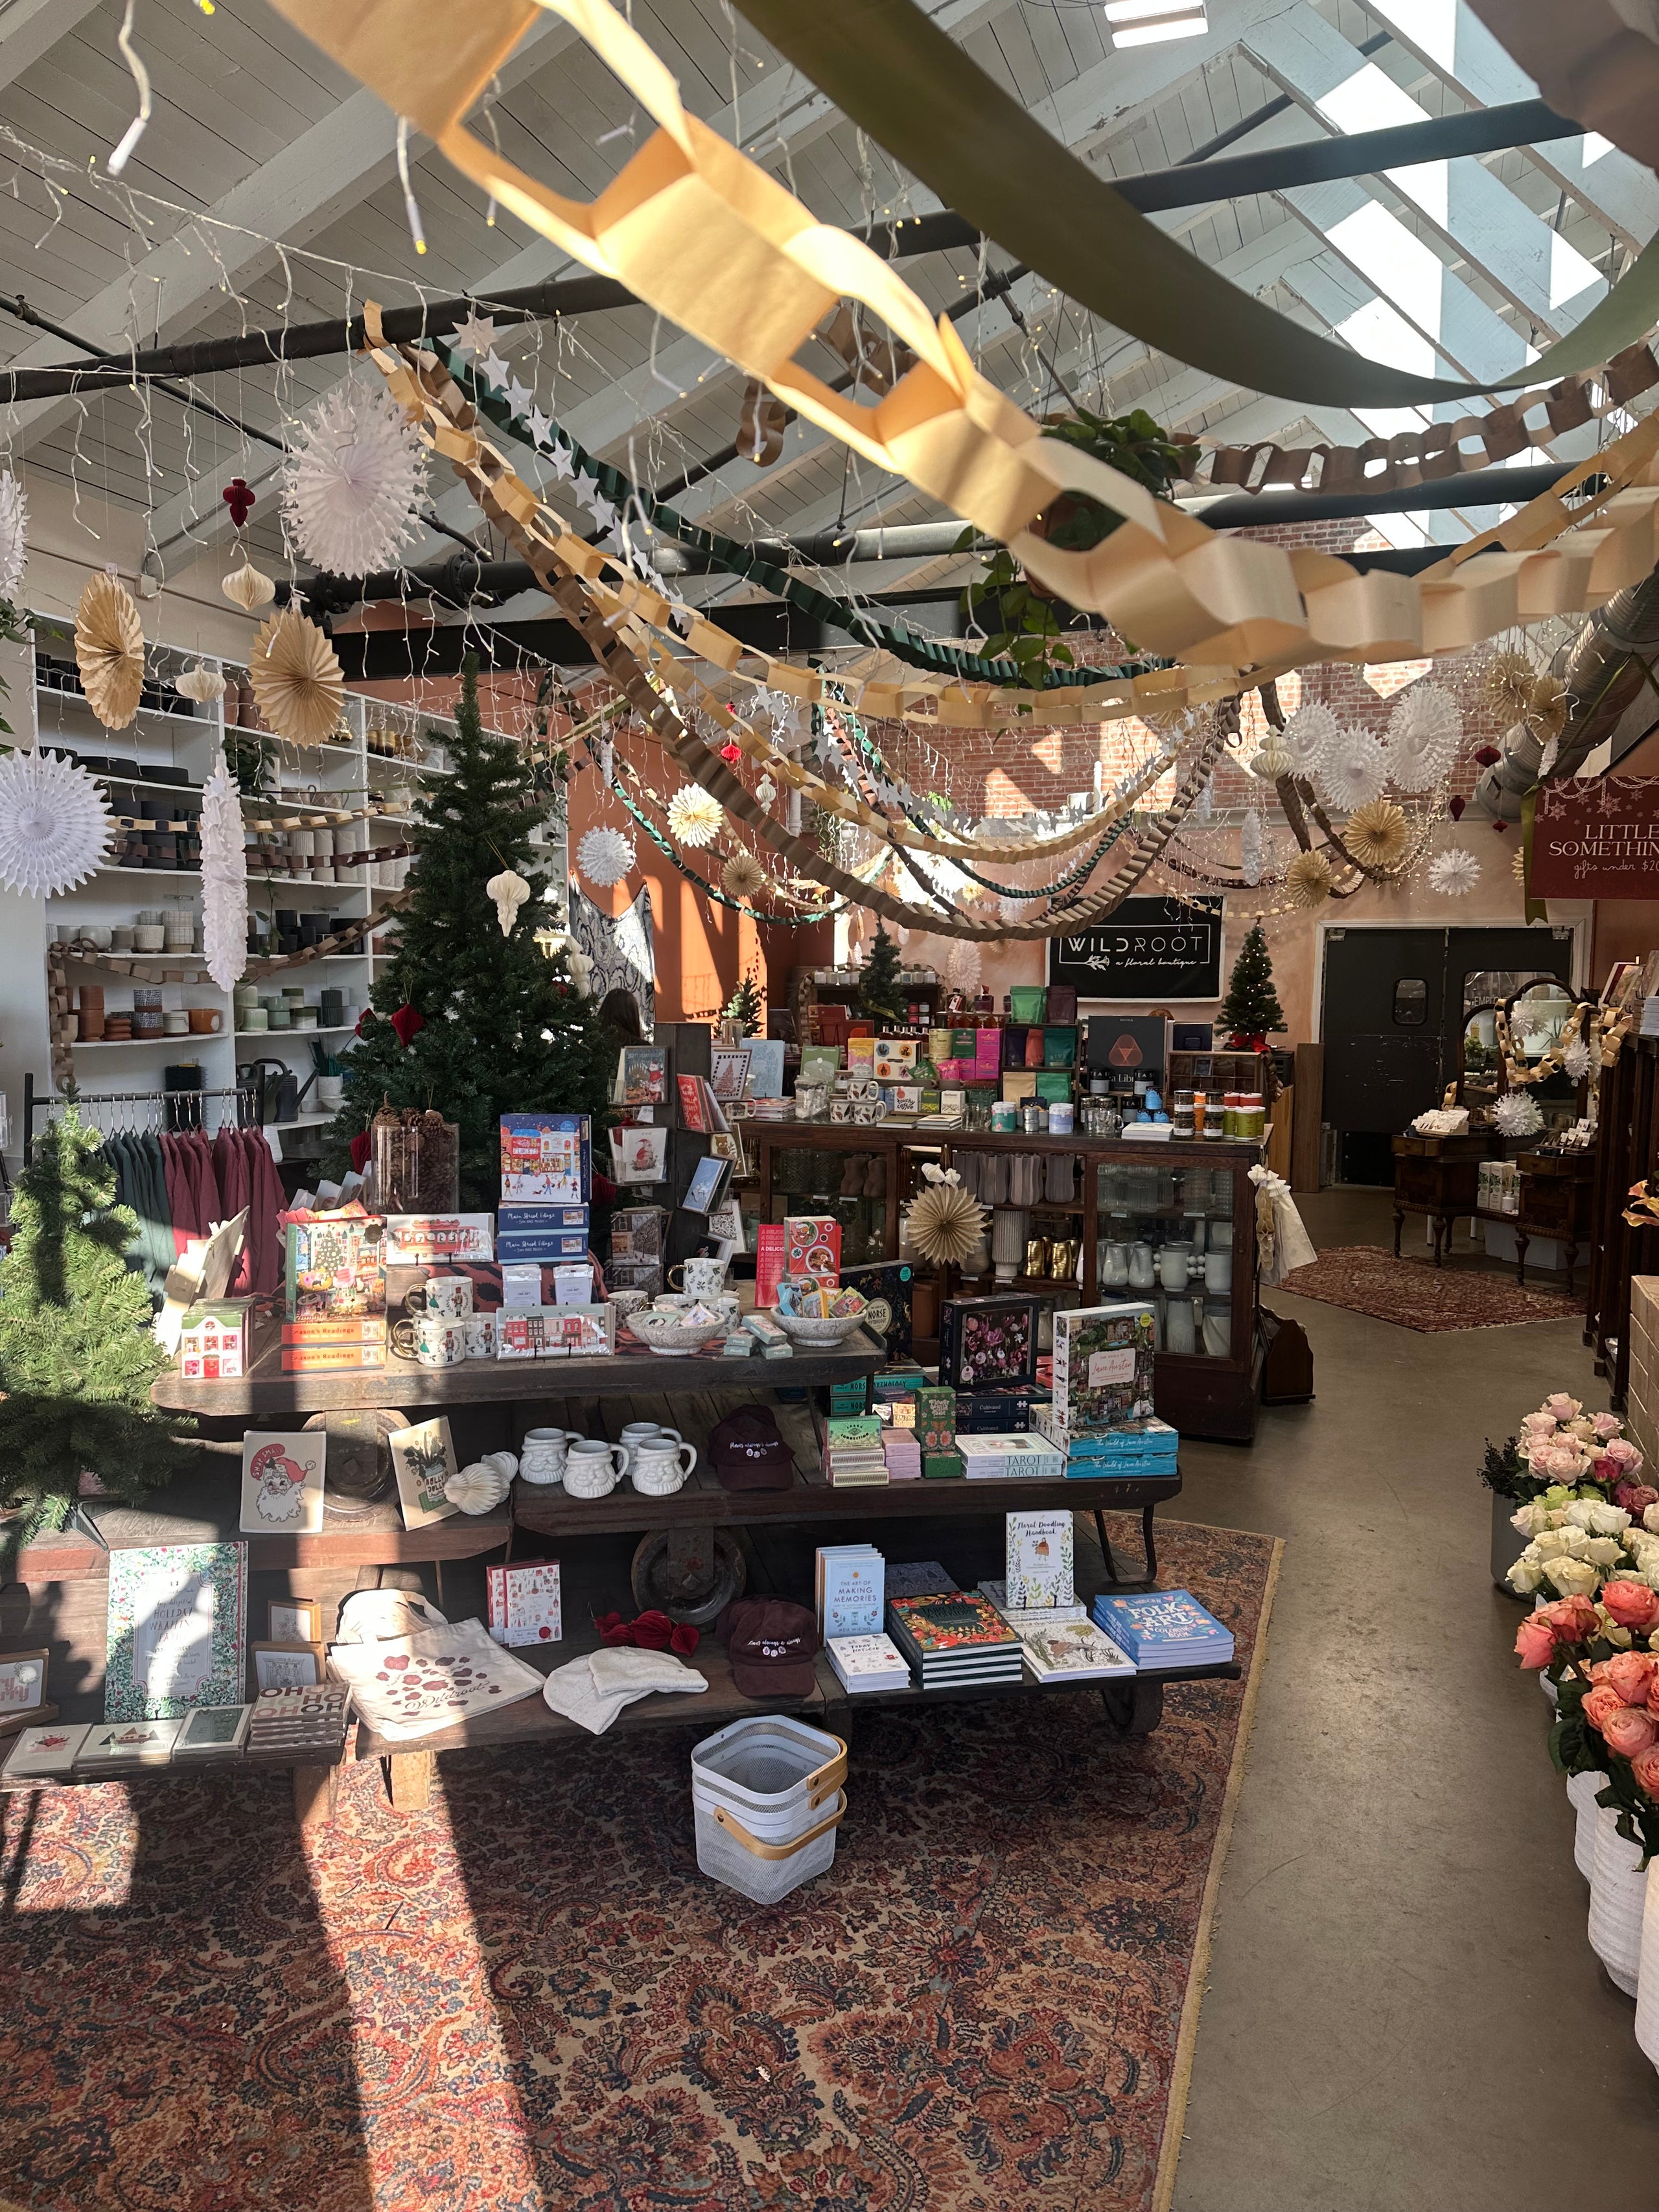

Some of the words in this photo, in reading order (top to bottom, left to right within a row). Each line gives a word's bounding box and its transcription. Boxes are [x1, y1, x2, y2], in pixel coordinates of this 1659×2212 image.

[1585, 824, 1659, 839] LITTLE
[1549, 841, 1659, 856] SOMETHIN
[1574, 859, 1598, 879] gifts
[1603, 859, 1636, 871] under
[1068, 937, 1202, 952] WILDROOT
[1124, 957, 1155, 968] floral
[1157, 957, 1197, 969] boutique
[868, 1309, 886, 1320] NORSE
[1091, 1362, 1108, 1375] Jane
[1109, 1358, 1131, 1372] Austen
[1007, 1455, 1041, 1465] TAROT
[1135, 1459, 1151, 1467] Austen
[1006, 1467, 1040, 1476] TAROT
[1038, 1520, 1065, 1529] Doodling
[1025, 1528, 1056, 1537] Handbook
[1128, 1601, 1184, 1620] FOLK
[1139, 1611, 1194, 1627] ART
[1155, 1625, 1194, 1633] COLORING
[405, 1681, 490, 1710] Wildroot
